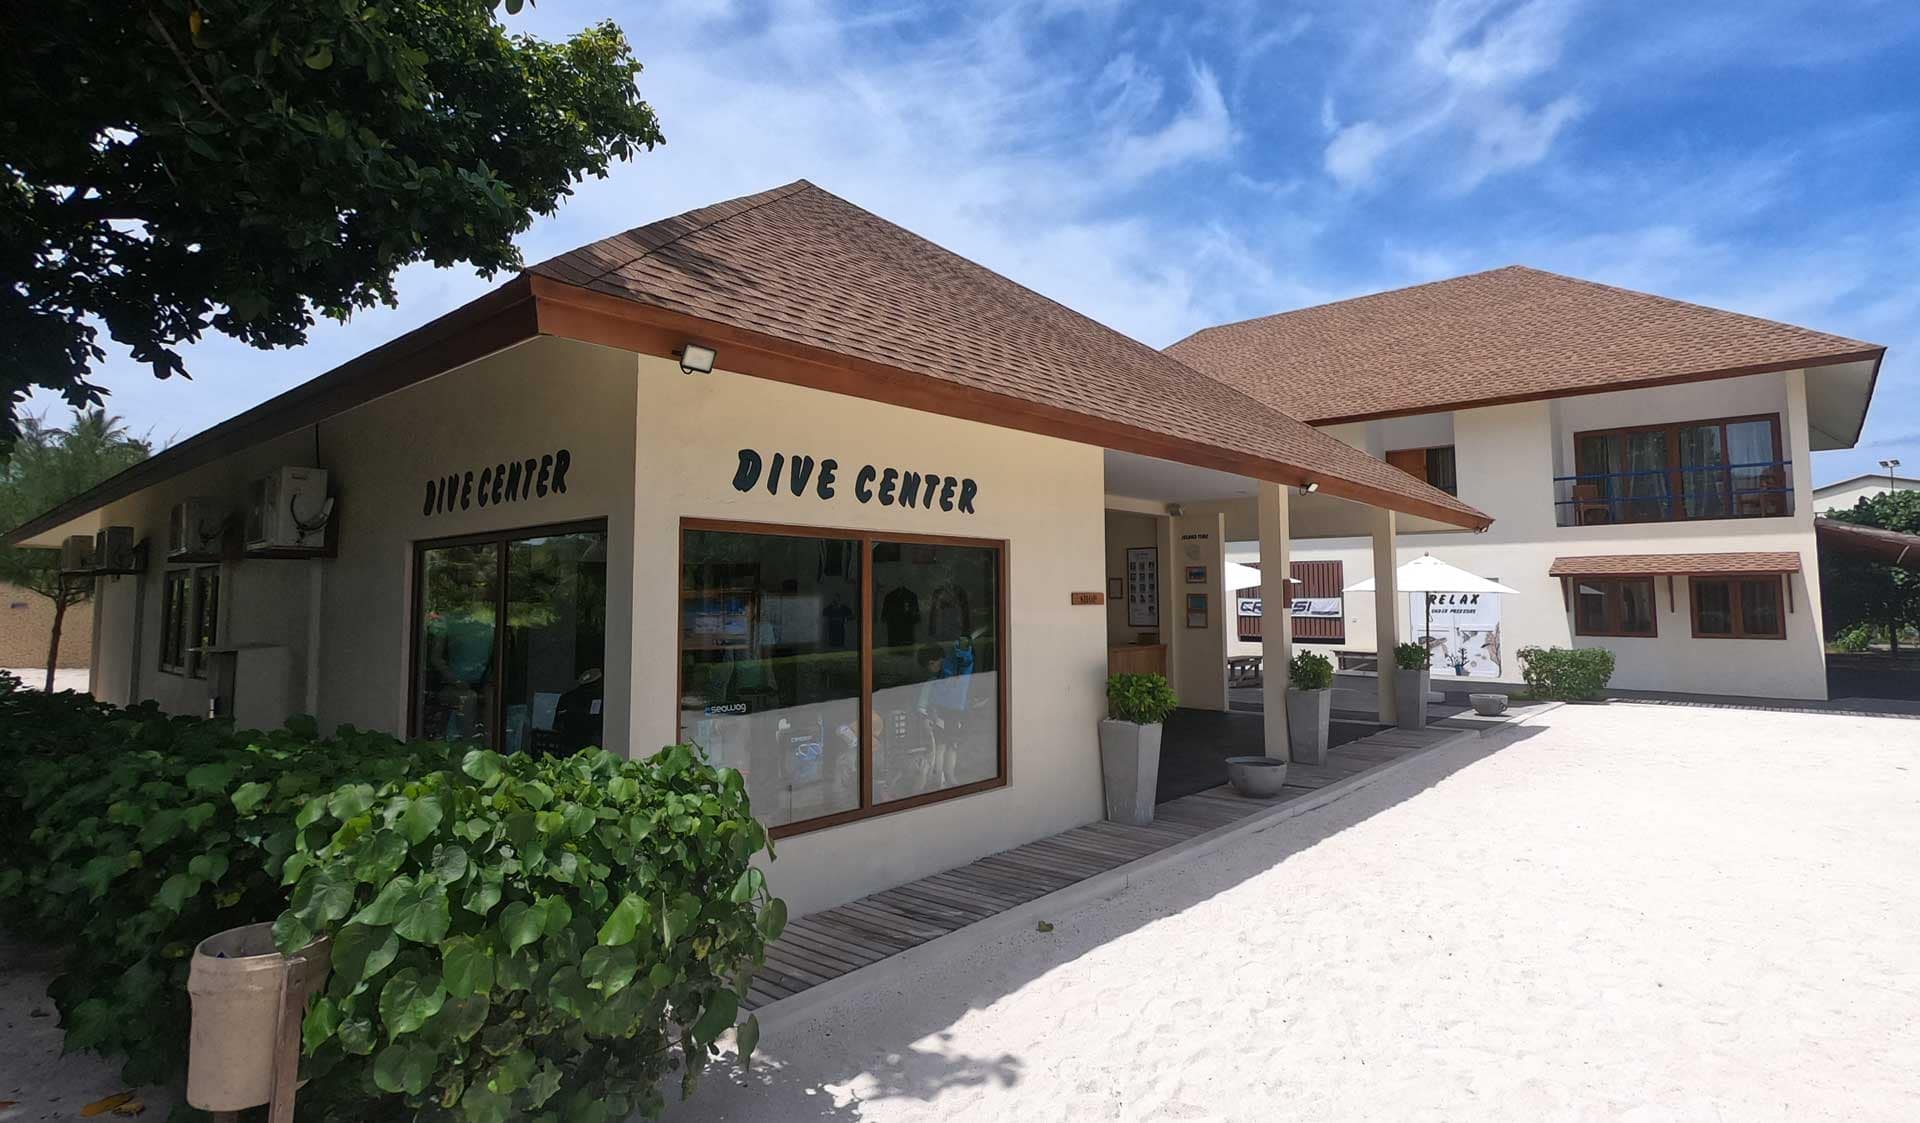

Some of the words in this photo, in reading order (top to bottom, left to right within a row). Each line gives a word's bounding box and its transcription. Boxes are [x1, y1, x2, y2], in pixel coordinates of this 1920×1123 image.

[423, 471, 473, 516] DIVE
[478, 449, 571, 508] CENTER
[732, 448, 838, 500] DIVE
[855, 464, 978, 514] CENTER
[1241, 601, 1312, 613] CRSI
[1429, 594, 1480, 605] RELAX
